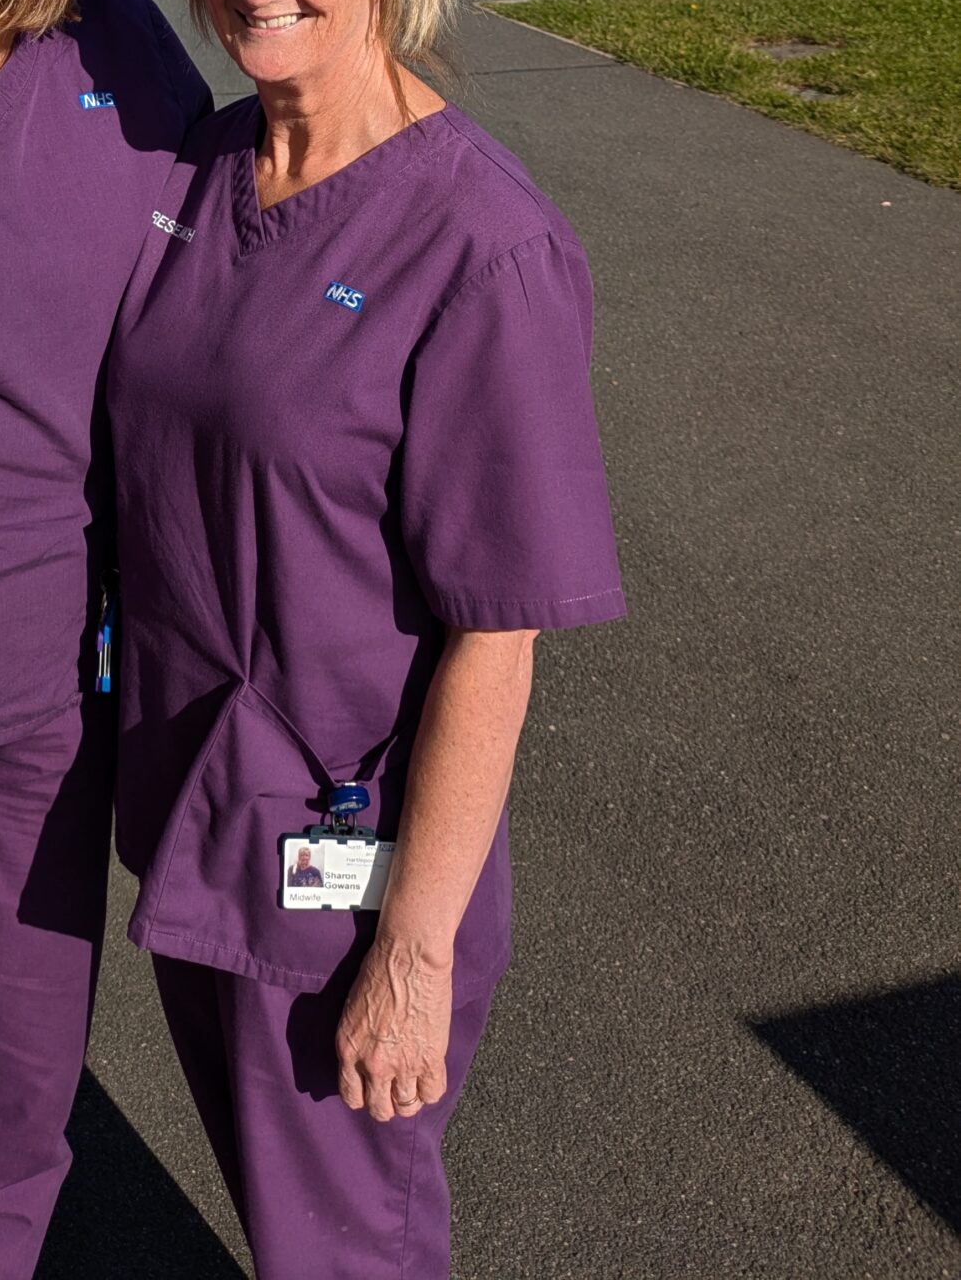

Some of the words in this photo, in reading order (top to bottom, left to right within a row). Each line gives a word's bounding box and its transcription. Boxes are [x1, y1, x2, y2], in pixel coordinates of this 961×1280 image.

[83, 92, 115, 109] NHS
[326, 284, 363, 308] NHS
[324, 871, 357, 880] Sharon
[324, 881, 361, 890] Gowans
[289, 893, 322, 902] Midwife
